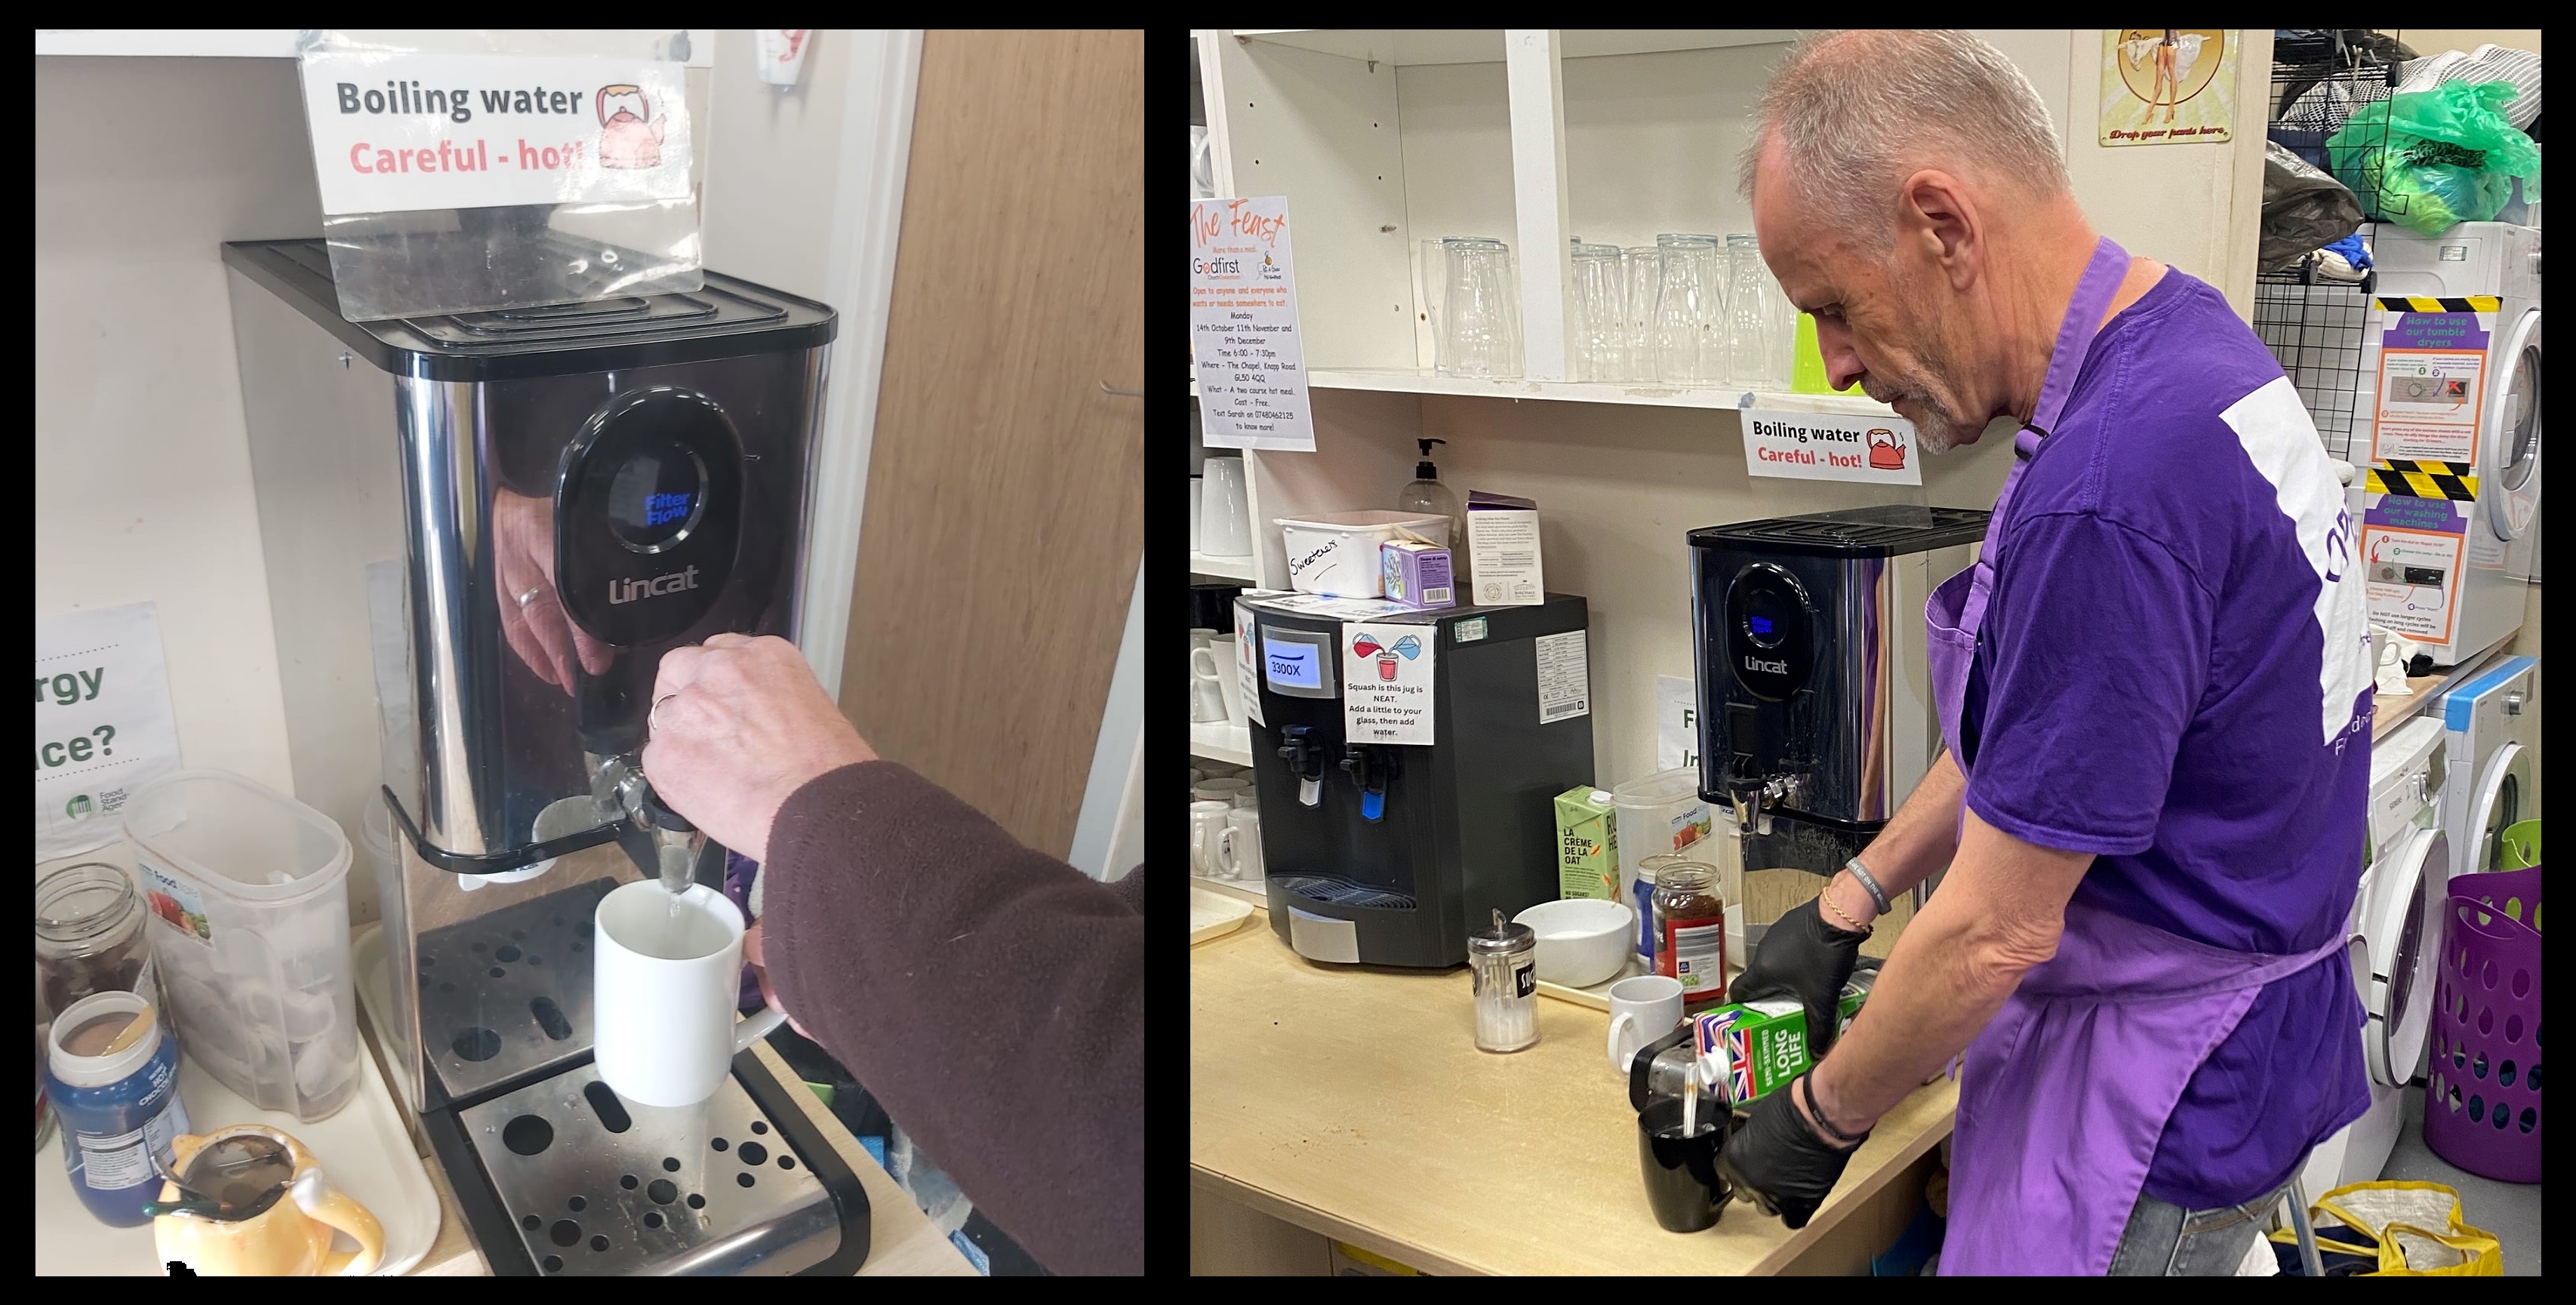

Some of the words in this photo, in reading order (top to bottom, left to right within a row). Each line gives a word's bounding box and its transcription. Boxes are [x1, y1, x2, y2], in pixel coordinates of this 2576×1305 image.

[337, 81, 472, 124] Boiling
[479, 86, 583, 115] water
[2110, 130, 2140, 141] Drop
[2141, 130, 2167, 140] your
[2168, 126, 2196, 139] pants
[2199, 125, 2225, 135] here
[349, 139, 488, 174] Careful
[498, 155, 509, 164] -
[518, 139, 583, 171] hot!
[1190, 204, 1222, 248] The
[1228, 198, 1285, 248] Feast
[1193, 257, 1240, 274] Godfirst
[1193, 287, 1207, 297] Open
[1216, 288, 1236, 297] anyone
[1238, 286, 1249, 294] and
[1250, 288, 1275, 297] everyone
[1276, 286, 1288, 294] who
[1230, 312, 1253, 322] Monday
[2406, 316, 2431, 326] How
[2434, 316, 2446, 326] to
[2448, 318, 2467, 326] use
[1196, 324, 1210, 332] 14th
[1211, 324, 1235, 332] October
[1236, 324, 1251, 332] 11th
[1252, 324, 1280, 332] November
[1281, 324, 1292, 332] and
[2405, 328, 2423, 337] our
[2427, 328, 2466, 337] tumble
[1224, 337, 1236, 345] 9th
[1237, 337, 1266, 345] December
[2417, 338, 2451, 348] dryers
[1217, 349, 1232, 357] Time
[1255, 349, 1276, 359] 7:30pm
[1201, 361, 1220, 369] Where
[1226, 361, 1239, 369] The
[1241, 362, 1262, 371] Chapel,
[1263, 362, 1280, 372] Knapp
[1281, 362, 1296, 371] Road
[1234, 374, 1250, 382] GL50
[1251, 374, 1266, 383] 4QQ
[1207, 385, 1222, 393] What
[1269, 386, 1279, 395] hot
[1280, 387, 1296, 396] meal.
[1234, 398, 1248, 406] Cost
[1255, 399, 1271, 407] Free.
[1212, 409, 1226, 417] Text
[1227, 410, 1245, 418] Sarah
[1244, 423, 1257, 431] know
[1753, 421, 1807, 443] Boiling
[1810, 428, 1860, 443] water
[1757, 447, 1816, 465] Careful
[1828, 451, 1863, 469] hot!
[645, 492, 691, 510] Filter
[2387, 496, 2412, 505] How
[2414, 498, 2426, 507] to
[646, 505, 688, 526] Flow
[2404, 508, 2448, 522] washing
[2390, 517, 2439, 528] machines
[1289, 539, 1339, 576] Sweeteners
[1271, 661, 1301, 676] 3300X
[1347, 683, 1377, 691] Squash
[1402, 685, 1415, 694] jug
[1356, 717, 1378, 725] glass,
[1564, 828, 1574, 837] LA
[1564, 836, 1593, 848] CRÈME
[1565, 847, 1576, 855] DE
[1578, 848, 1588, 857] LA
[1565, 856, 1581, 865] OAT
[1775, 1029, 1791, 1078] LONG
[1788, 1031, 1803, 1067] LIFE
[1762, 1029, 1774, 1088] SEMI-SKIMMED
